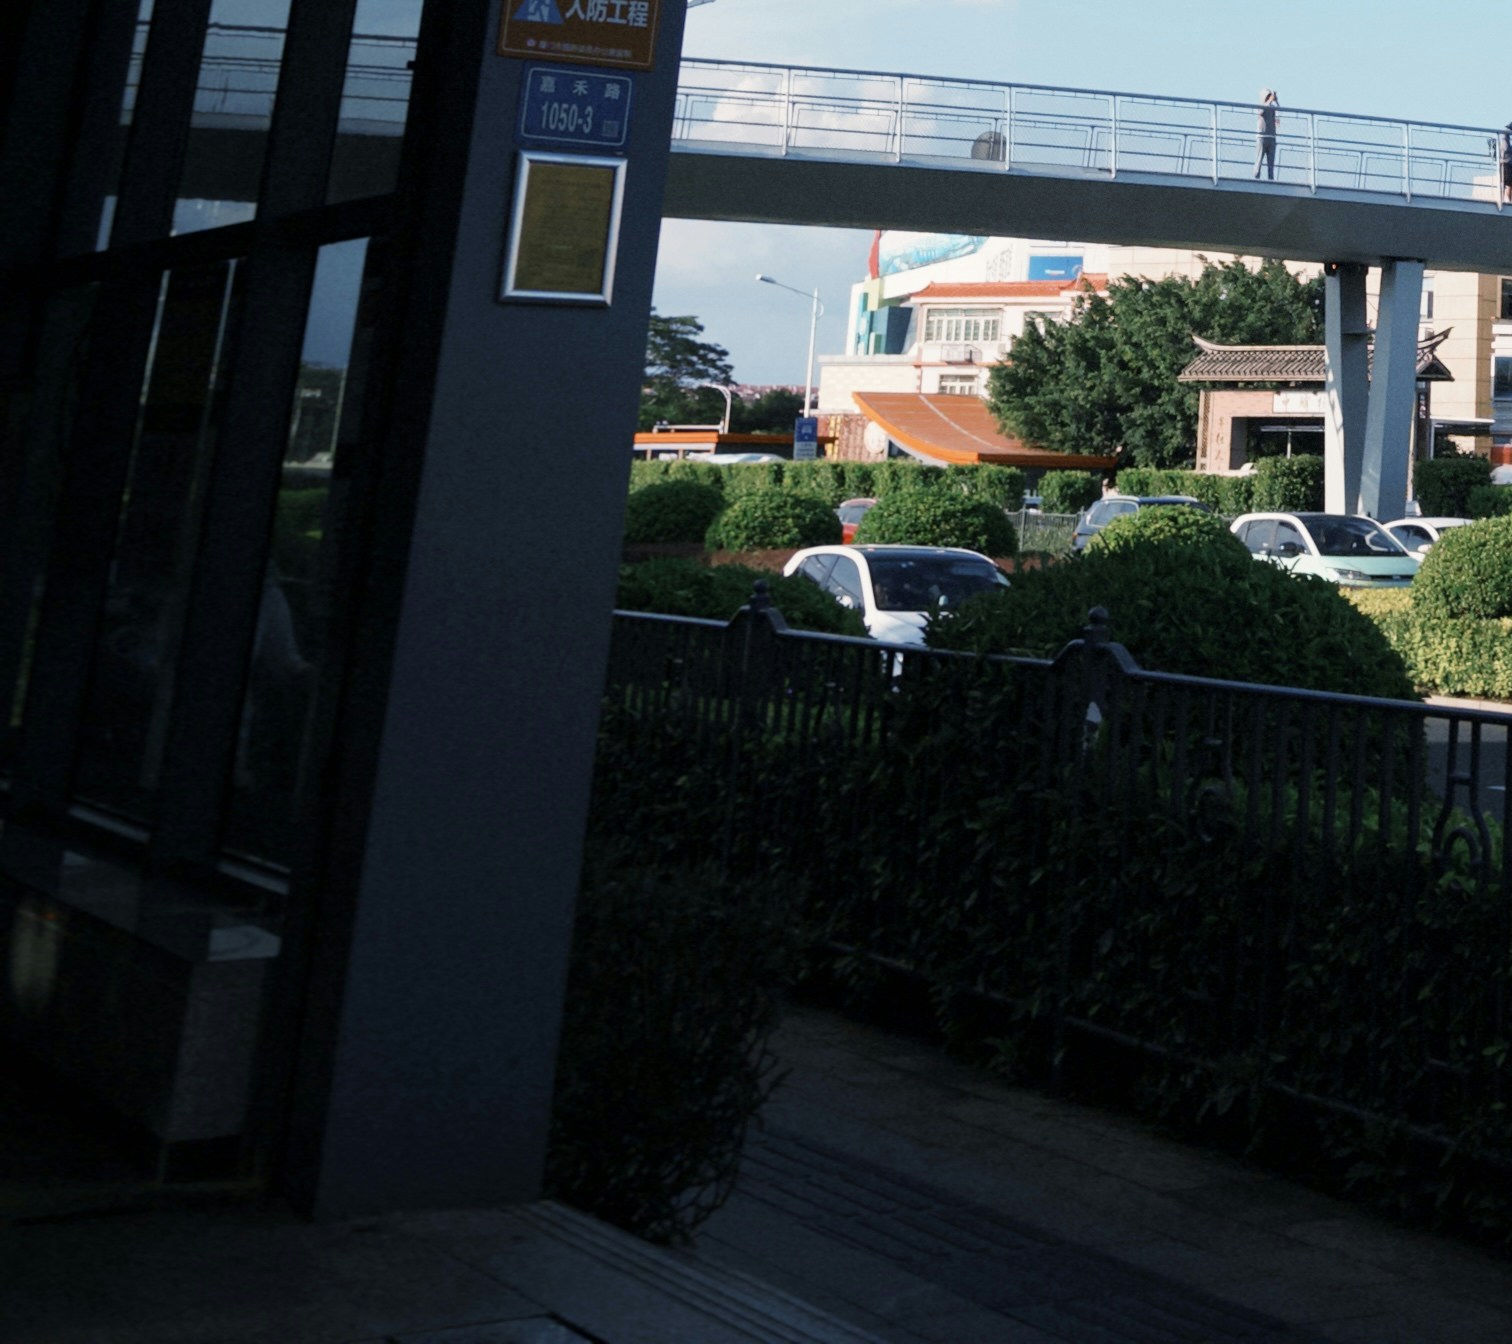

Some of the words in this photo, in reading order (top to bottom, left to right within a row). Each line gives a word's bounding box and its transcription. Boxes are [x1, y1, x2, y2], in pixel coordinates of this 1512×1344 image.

[540, 75, 621, 100] 嘉禾路
[541, 101, 593, 134] 1050-3
